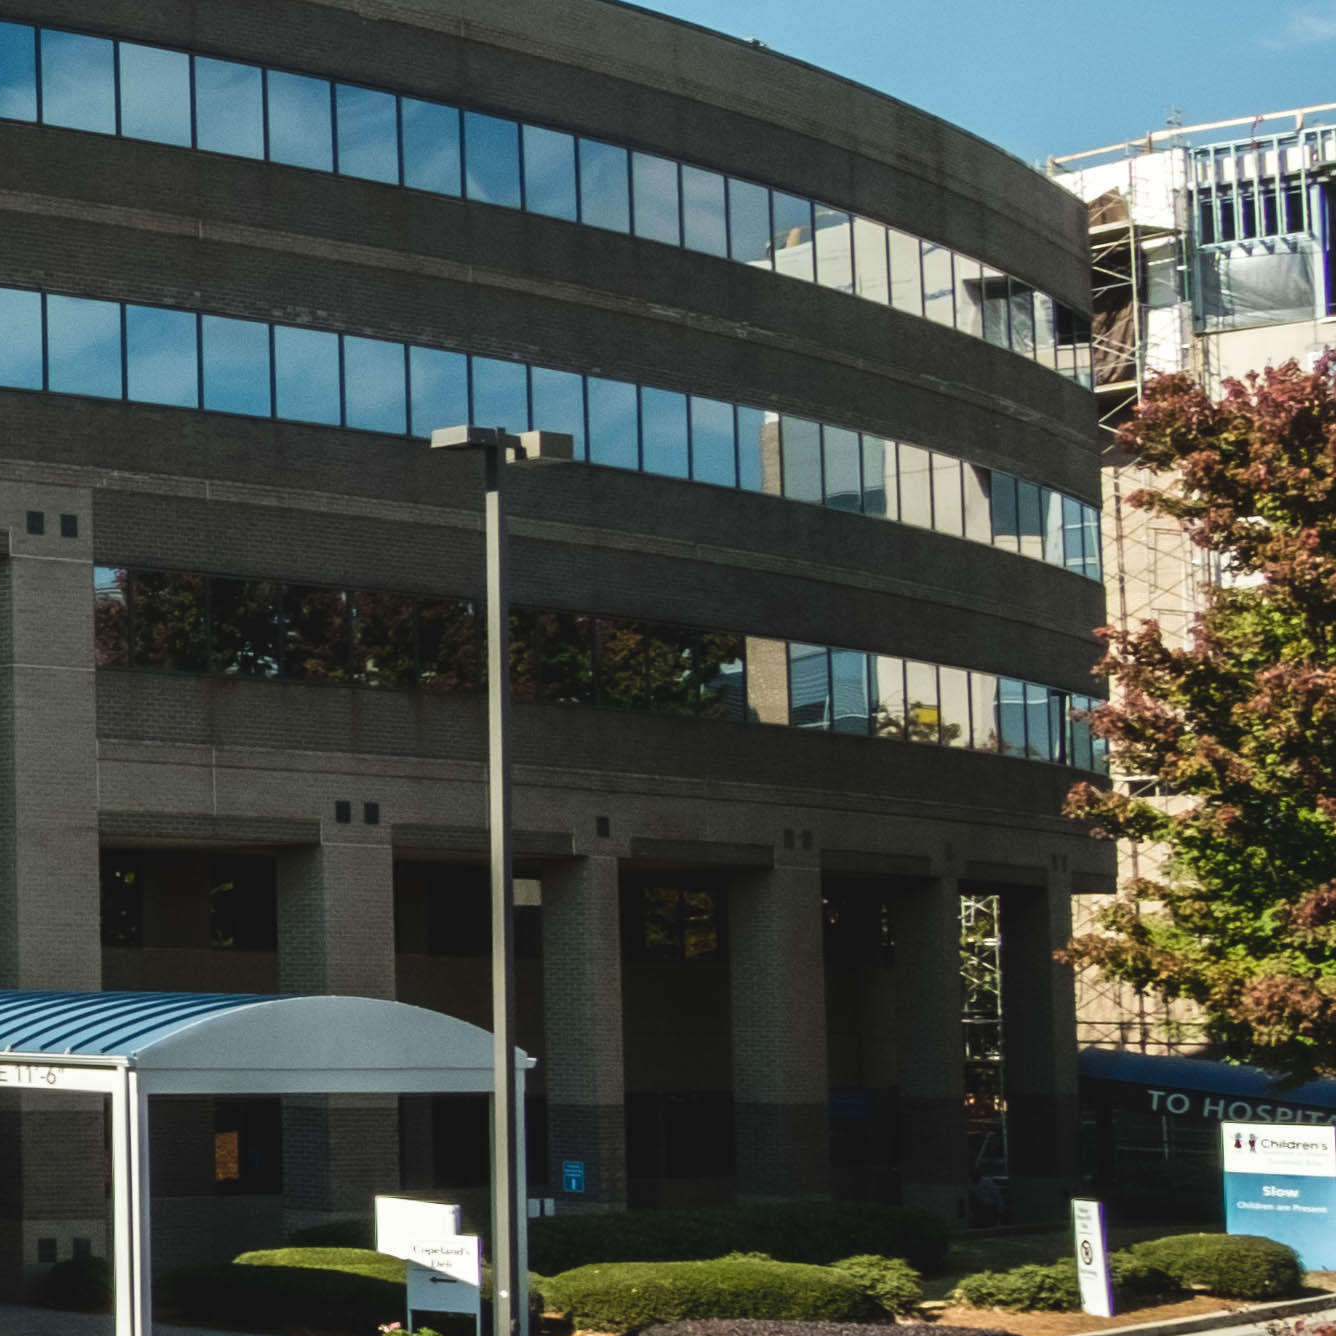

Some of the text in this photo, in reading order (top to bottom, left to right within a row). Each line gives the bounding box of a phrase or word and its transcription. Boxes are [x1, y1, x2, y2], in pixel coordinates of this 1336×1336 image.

[1147, 1089, 1190, 1114] TO
[1260, 1138, 1328, 1151] Childrens
[1262, 1185, 1299, 1198] Slow
